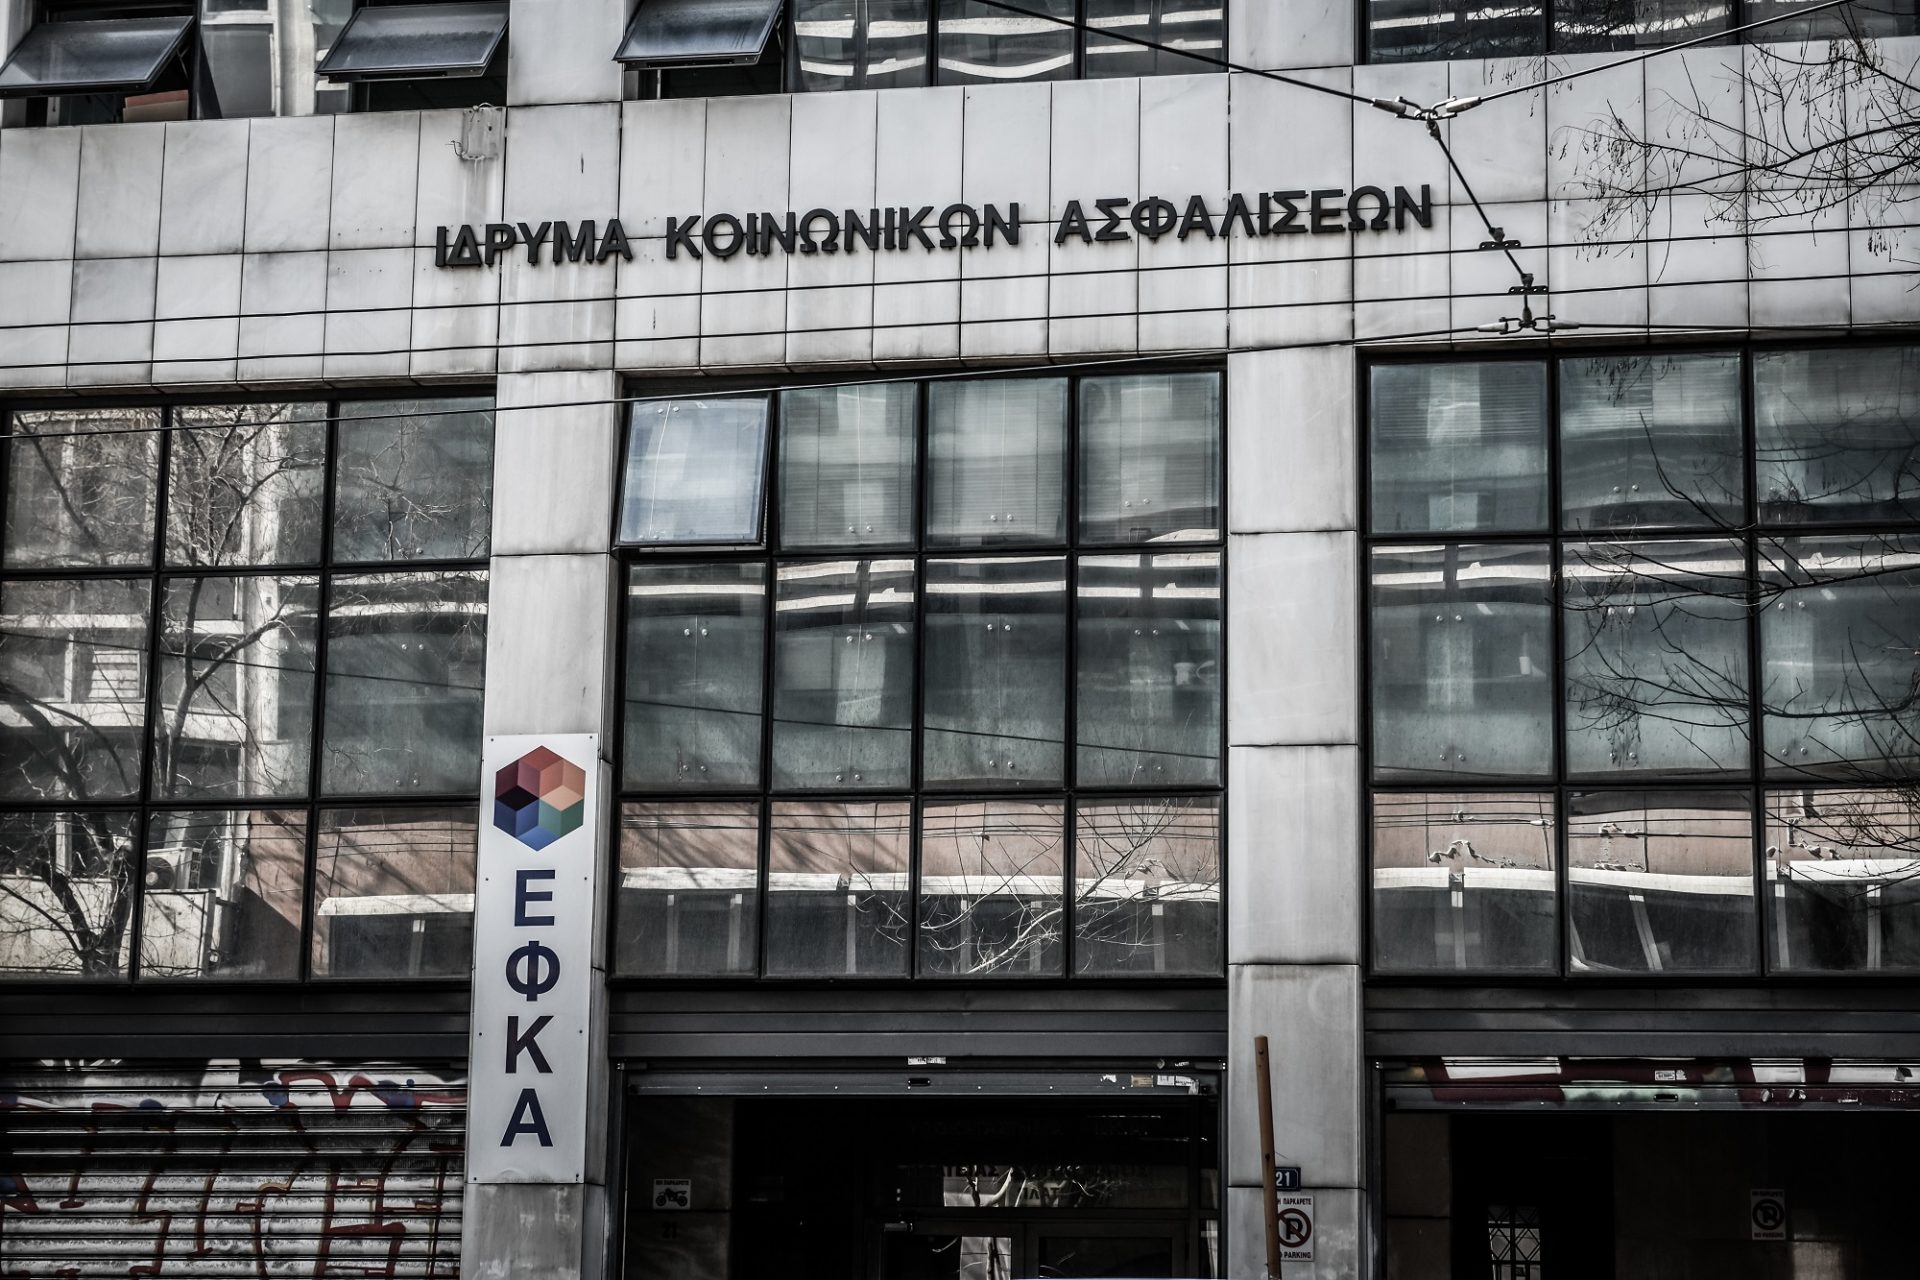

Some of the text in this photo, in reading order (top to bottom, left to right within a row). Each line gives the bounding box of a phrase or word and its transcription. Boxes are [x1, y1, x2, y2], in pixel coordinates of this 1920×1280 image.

[435, 184, 1432, 268] ΙΔΡΥΜΑ ΚΟΙΝΩΝΙΚΩΝ ΑΣΦΑΛΙΣΕΩΝ
[500, 869, 561, 1147] ΕΦΚΑ
[1275, 1171, 1291, 1186] 21
[1283, 1251, 1312, 1259] PARKING
